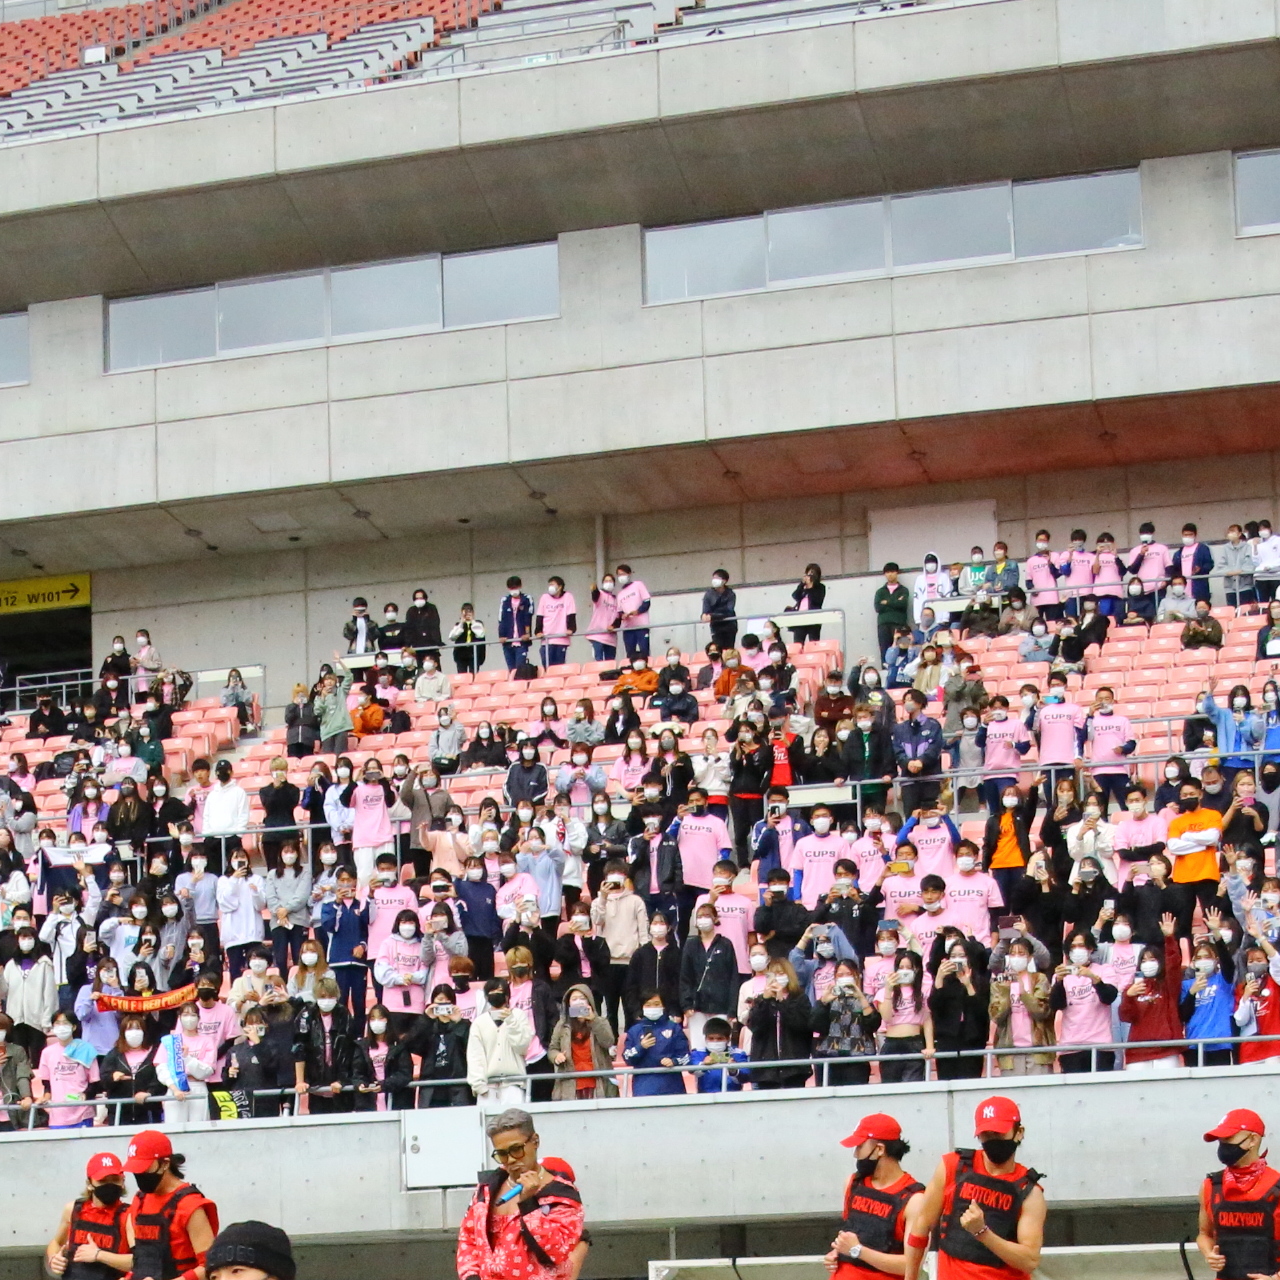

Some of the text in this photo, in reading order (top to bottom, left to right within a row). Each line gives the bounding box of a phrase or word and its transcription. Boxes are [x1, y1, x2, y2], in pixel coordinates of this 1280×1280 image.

[27, 591, 60, 603] W101
[1043, 713, 1073, 722] CUPS
[1093, 725, 1121, 734] CUPS
[987, 731, 1017, 740] CUPS
[682, 824, 713, 834] CUPS
[805, 850, 836, 859] CUPS
[949, 889, 982, 898] CUPS
[374, 897, 405, 905] CUPS
[960, 1182, 1013, 1211] NEOTOKYO
[851, 1195, 892, 1218] CRAZYBOY
[1218, 1210, 1265, 1227] CRAZYBOY
